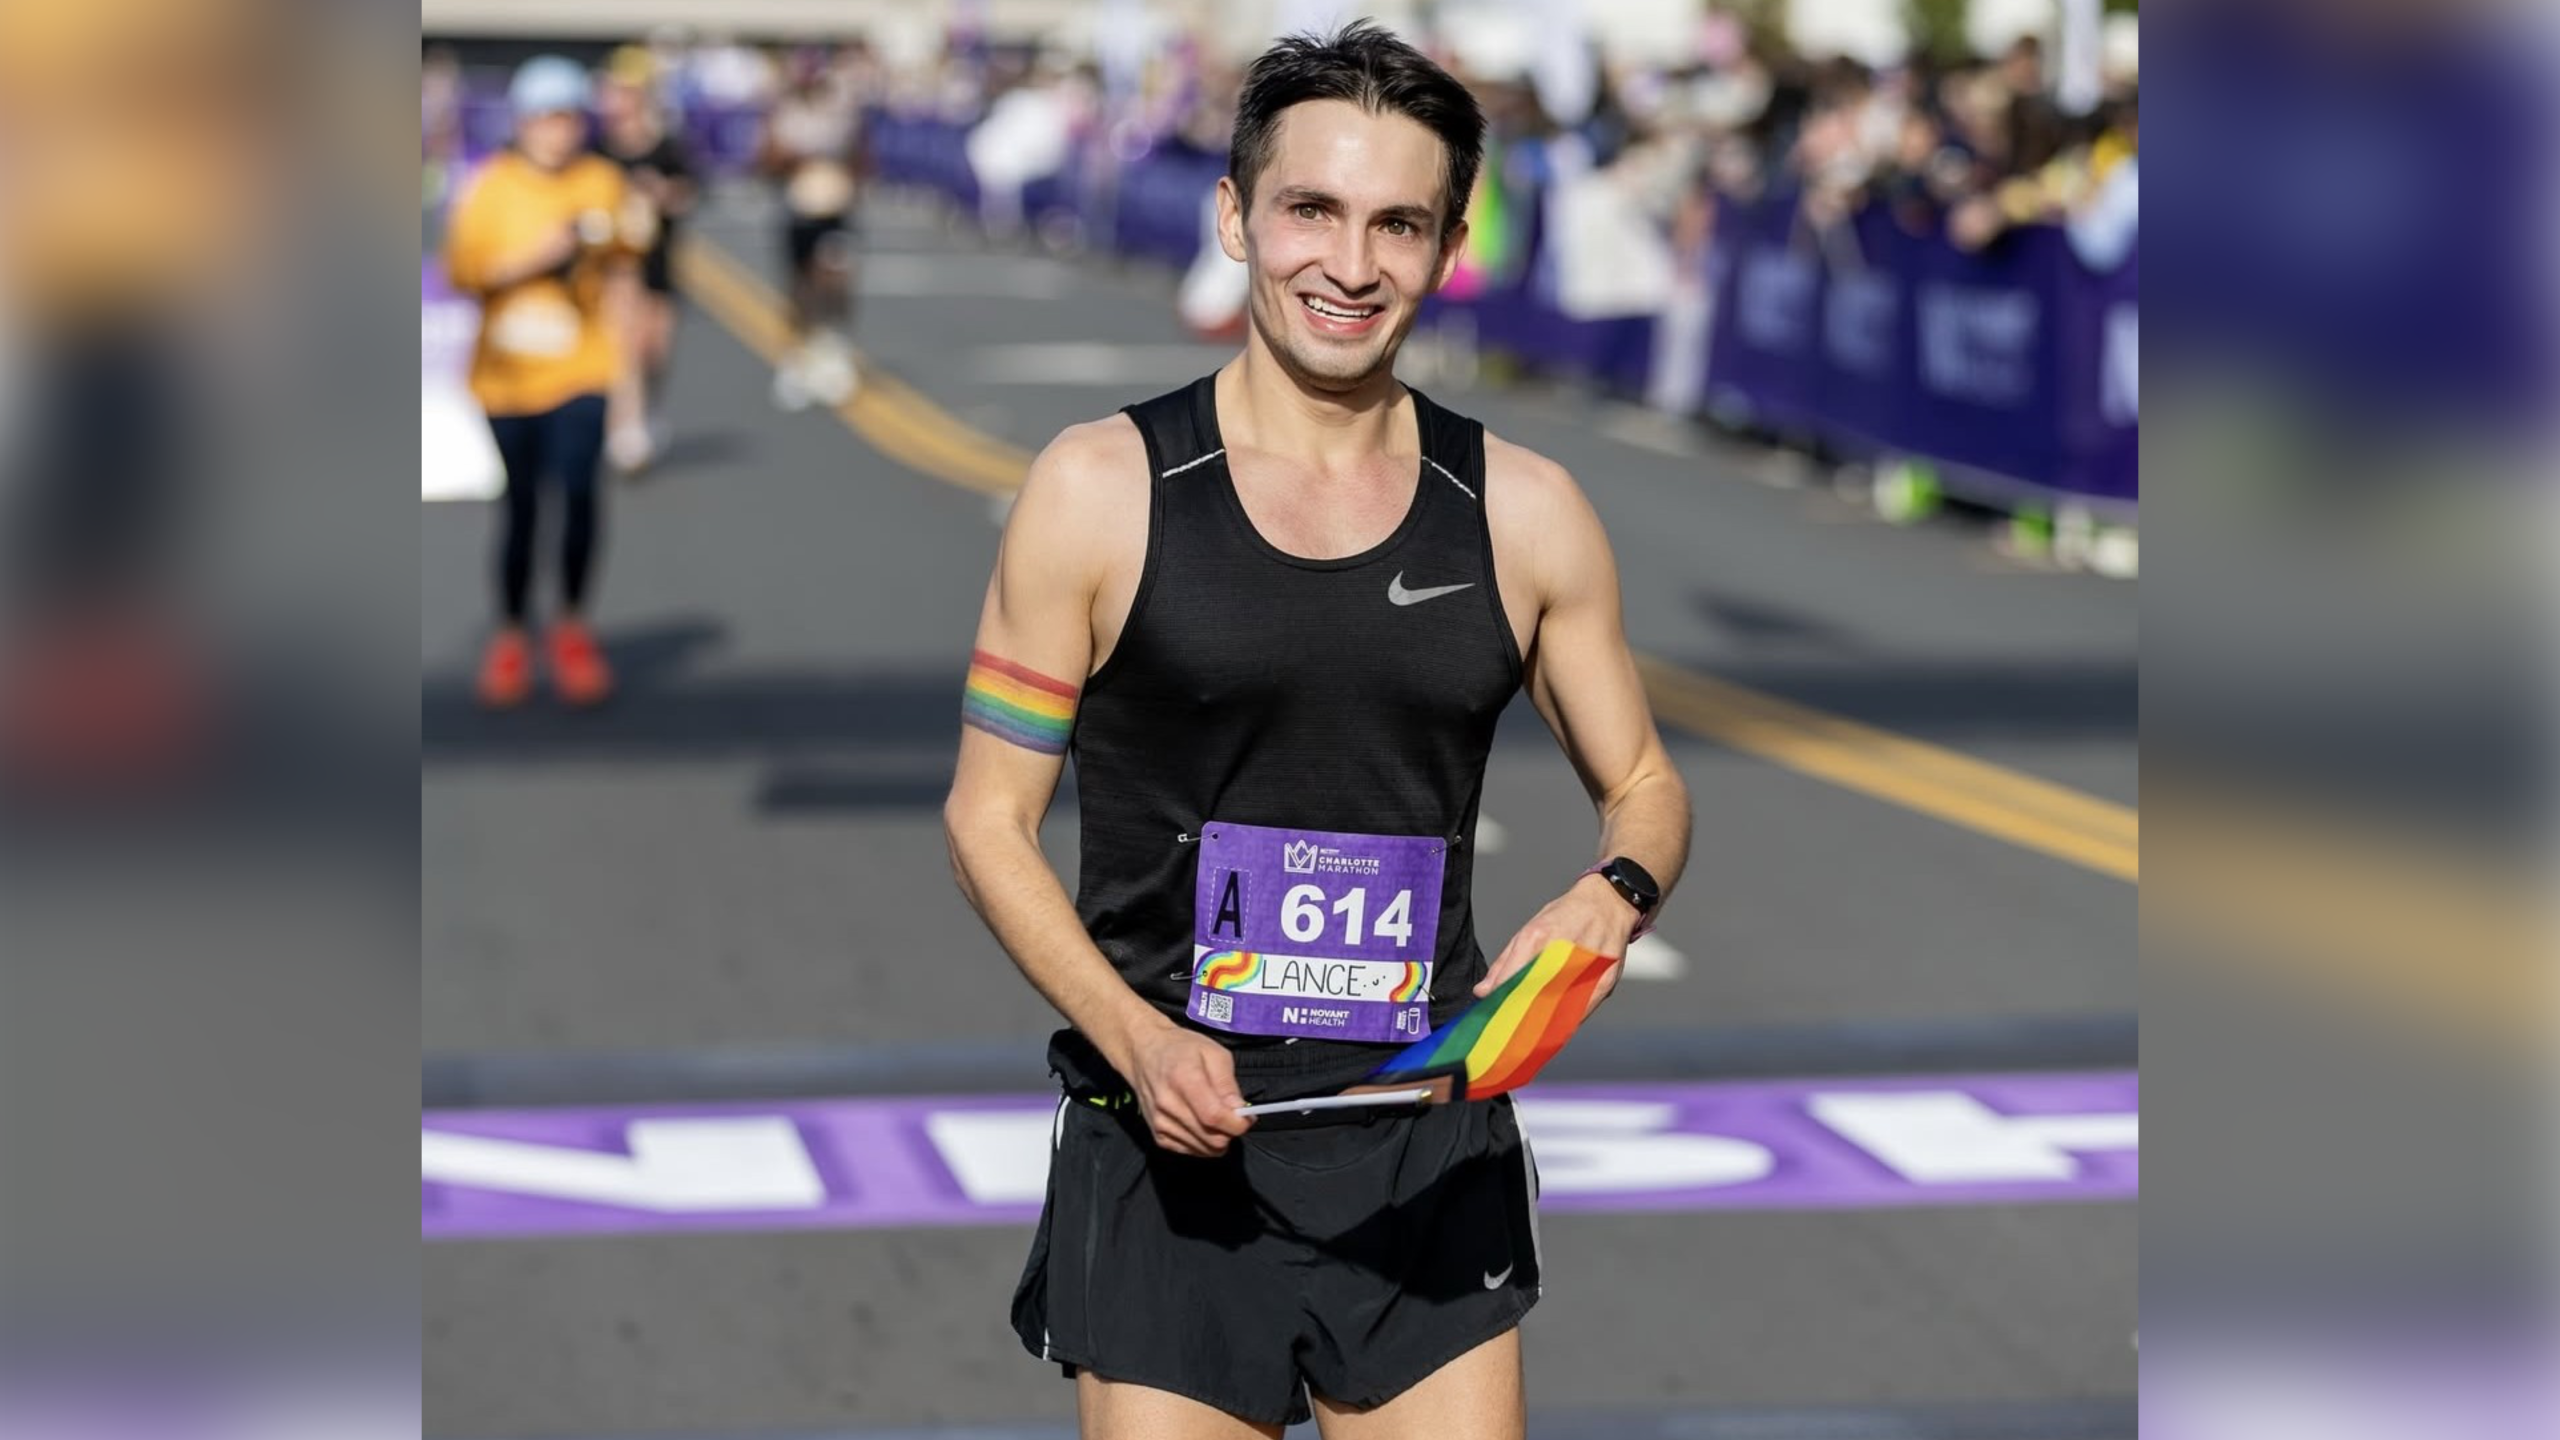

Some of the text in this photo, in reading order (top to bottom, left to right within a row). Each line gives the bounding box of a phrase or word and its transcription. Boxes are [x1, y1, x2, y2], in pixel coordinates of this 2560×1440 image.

[1319, 856, 1380, 868] CHARLOTTE
[1318, 864, 1379, 876] MARATHON
[1212, 870, 1242, 938] A
[1280, 884, 1413, 948] 614
[1261, 960, 1367, 997] LANCE
[1309, 1008, 1350, 1019] NOVANT
[1308, 1017, 1346, 1027] HEALTH
